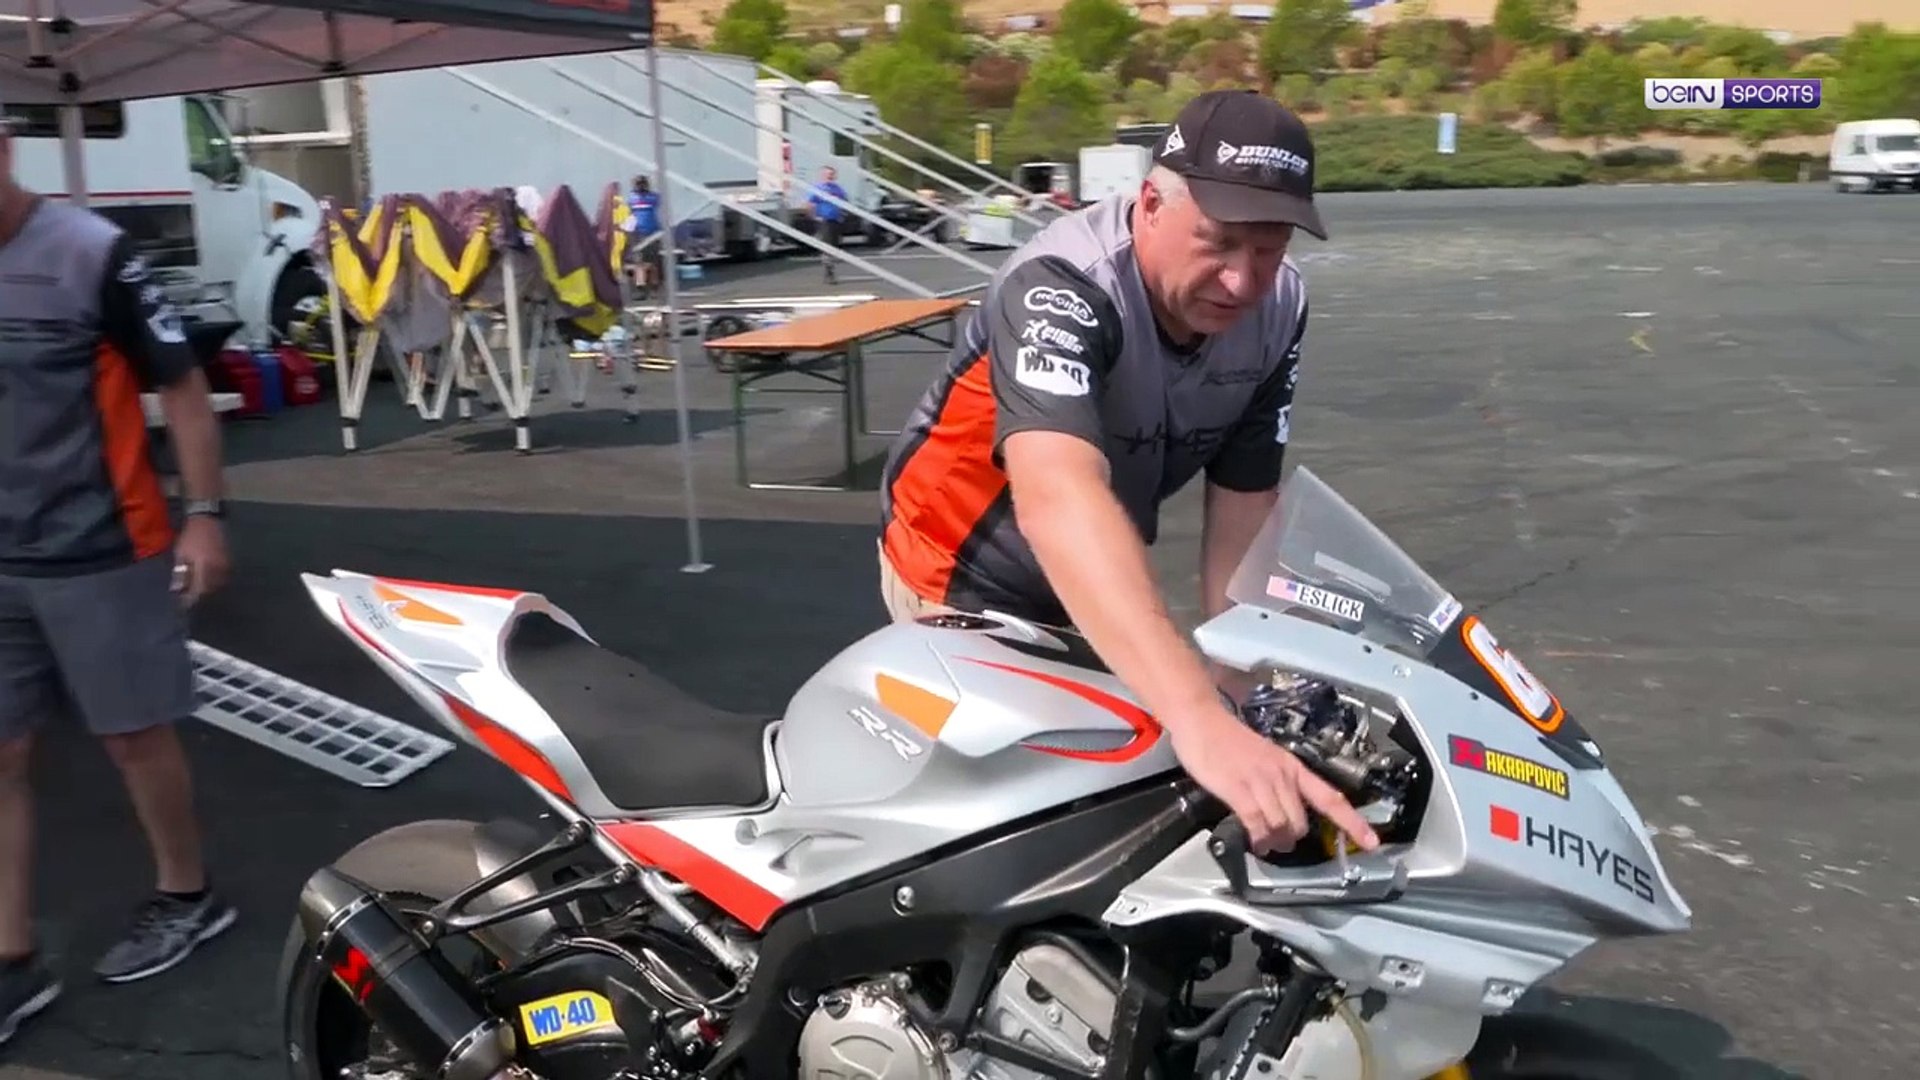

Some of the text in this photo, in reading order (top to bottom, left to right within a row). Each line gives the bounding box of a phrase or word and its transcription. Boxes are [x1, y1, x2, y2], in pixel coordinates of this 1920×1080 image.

[1300, 585, 1362, 620] ESLICK
[1525, 816, 1655, 904] HAYES
[529, 997, 596, 1036] WD-40
